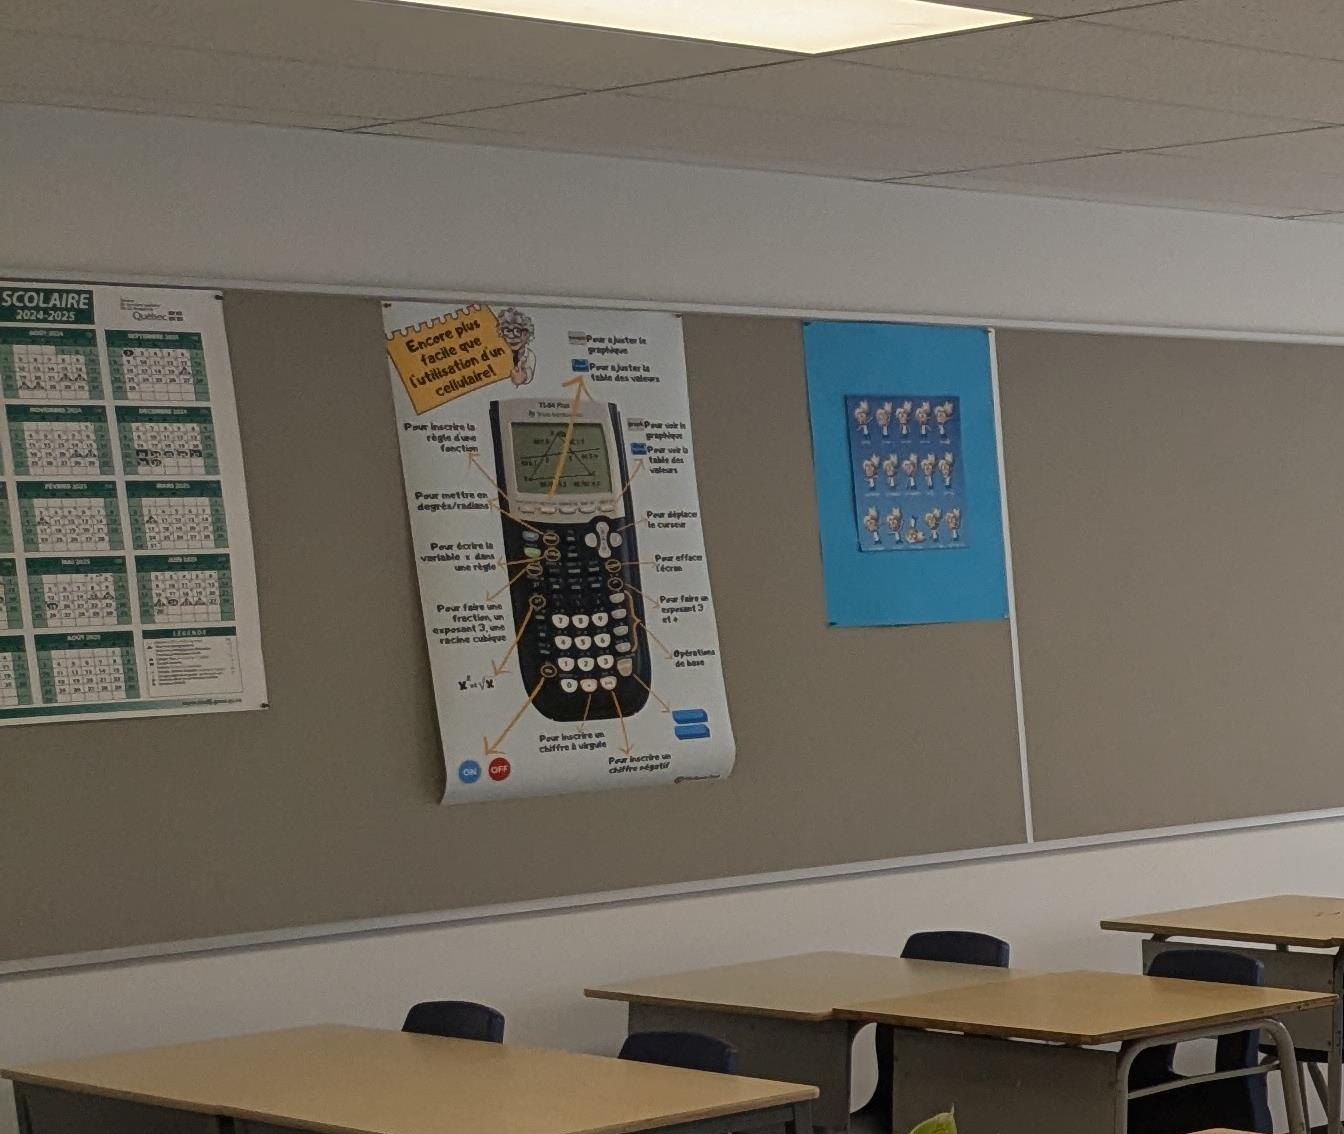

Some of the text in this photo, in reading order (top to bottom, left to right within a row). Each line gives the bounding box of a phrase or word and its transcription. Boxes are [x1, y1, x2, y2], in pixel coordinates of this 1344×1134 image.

[2, 291, 90, 309] SCOLAIRE
[16, 310, 76, 320] 2024-2025
[133, 311, 168, 321] Québec
[405, 319, 481, 353] Encore plus
[586, 335, 605, 343] Pour
[608, 336, 637, 346] ajuster
[420, 336, 482, 366] facile que
[588, 346, 628, 355] graphique
[409, 346, 506, 388] l'utilisation d'un
[589, 363, 608, 372] Pour
[610, 364, 641, 374] ajuster
[435, 364, 497, 396] cellulaire!
[591, 373, 612, 382] table
[631, 374, 660, 383] valeurs
[404, 422, 475, 431] Pour inscrire la
[644, 421, 663, 429] Pour
[426, 434, 451, 443] règle
[646, 432, 683, 441] graphique
[440, 444, 478, 453] fonction
[647, 446, 667, 454] Pour
[668, 446, 681, 454] voir
[649, 456, 684, 464] table des
[649, 466, 678, 474] valeurs
[415, 492, 438, 500] Pour
[441, 490, 475, 499] mettre
[646, 511, 665, 519] Pour
[657, 521, 686, 529] curseur
[430, 541, 493, 551] Pour écrire la
[420, 553, 460, 562] variable
[474, 552, 495, 560] dans
[655, 554, 674, 562] Pour
[454, 561, 497, 571] une règle
[660, 595, 678, 603] Pour
[680, 595, 699, 603] faire
[436, 604, 461, 613] Pour
[463, 602, 485, 612] faire
[661, 604, 704, 614] exposant 3
[662, 616, 671, 624] et
[432, 624, 477, 635] exposant
[489, 624, 505, 632] une
[439, 633, 507, 645] racine cubique
[673, 649, 716, 660] Opérations
[686, 659, 705, 667] base
[539, 733, 559, 744] Pour
[561, 732, 593, 742] inscrire
[539, 741, 570, 752] chiffre
[578, 741, 607, 751] virgule
[608, 757, 628, 765] Pour
[629, 754, 660, 763] inscrire
[463, 768, 477, 776] ON
[490, 765, 508, 774] OFF
[608, 762, 670, 774] chiffre négatif
